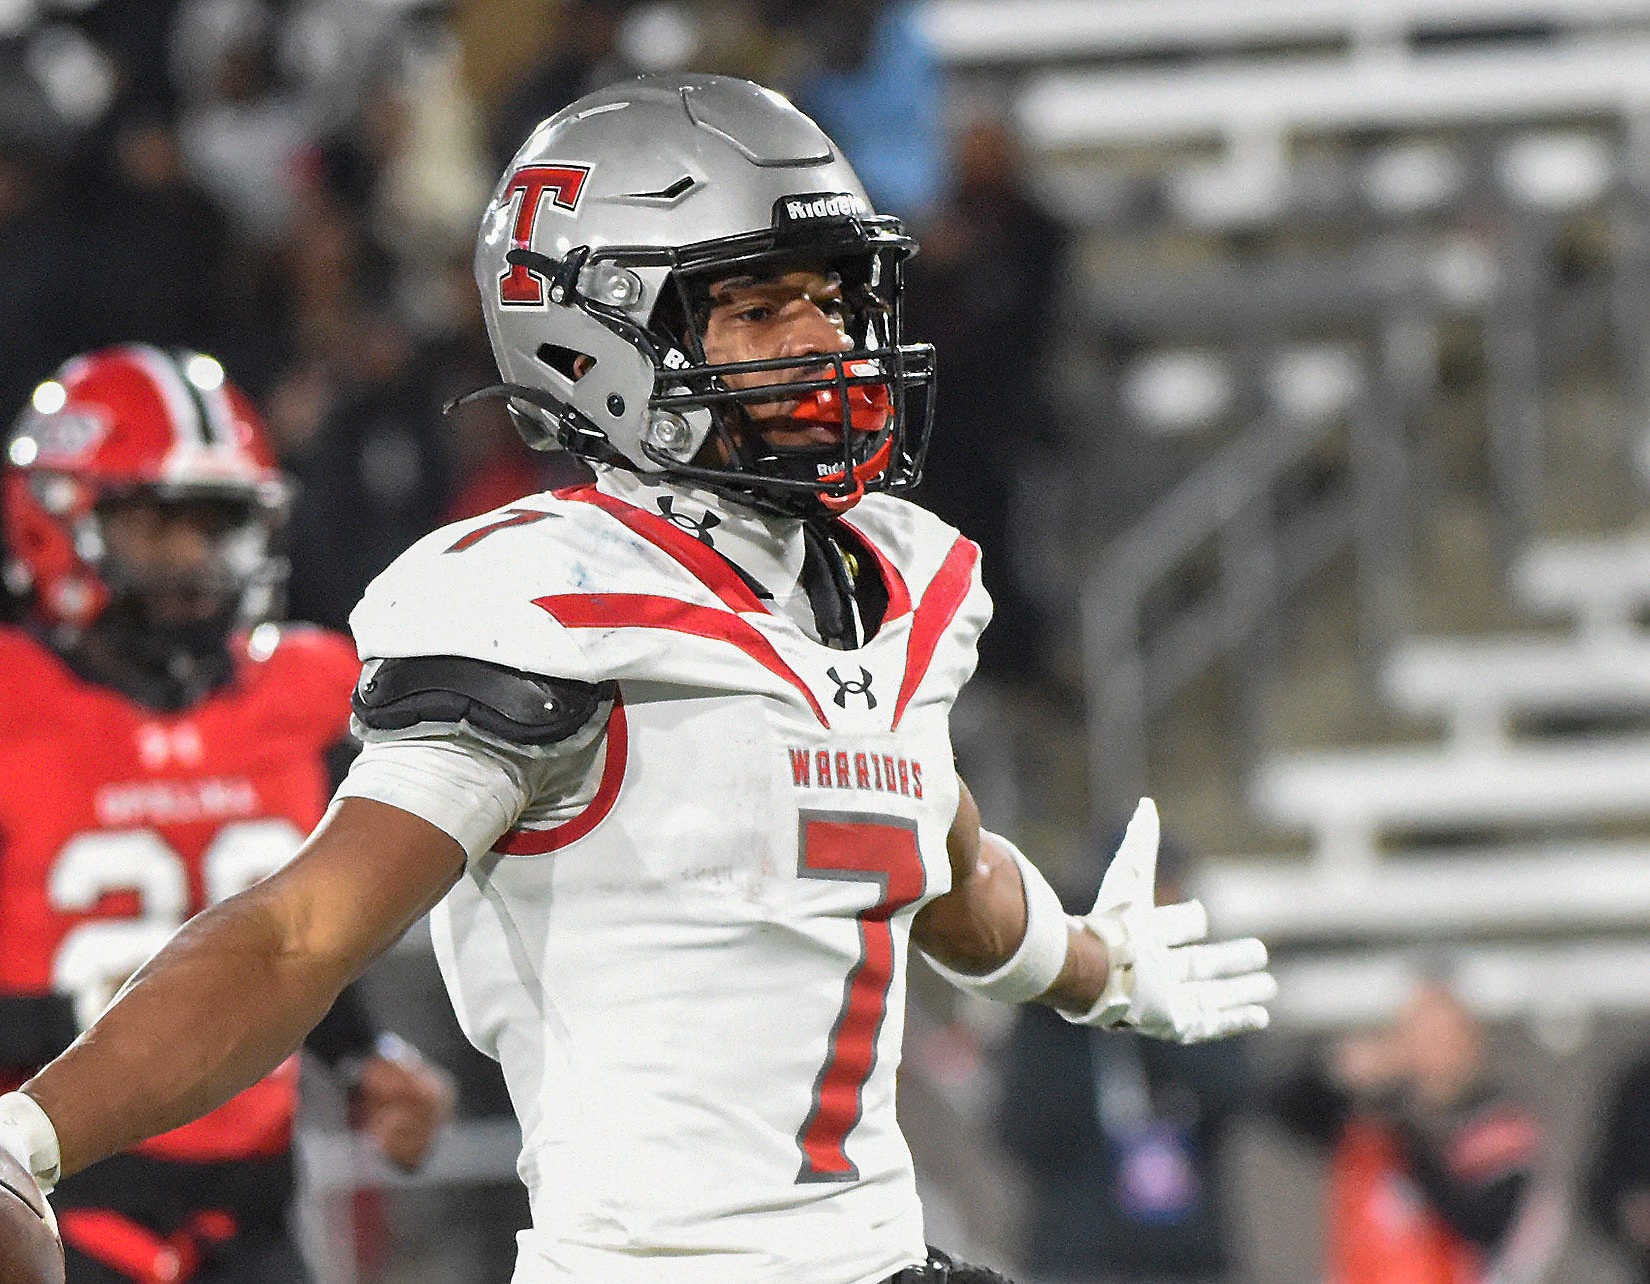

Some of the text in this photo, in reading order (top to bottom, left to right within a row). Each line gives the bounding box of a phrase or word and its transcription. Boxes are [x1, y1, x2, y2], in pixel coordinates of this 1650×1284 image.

[499, 162, 594, 309] T
[788, 745, 923, 800] WARRIORS
[795, 808, 927, 1185] 7
